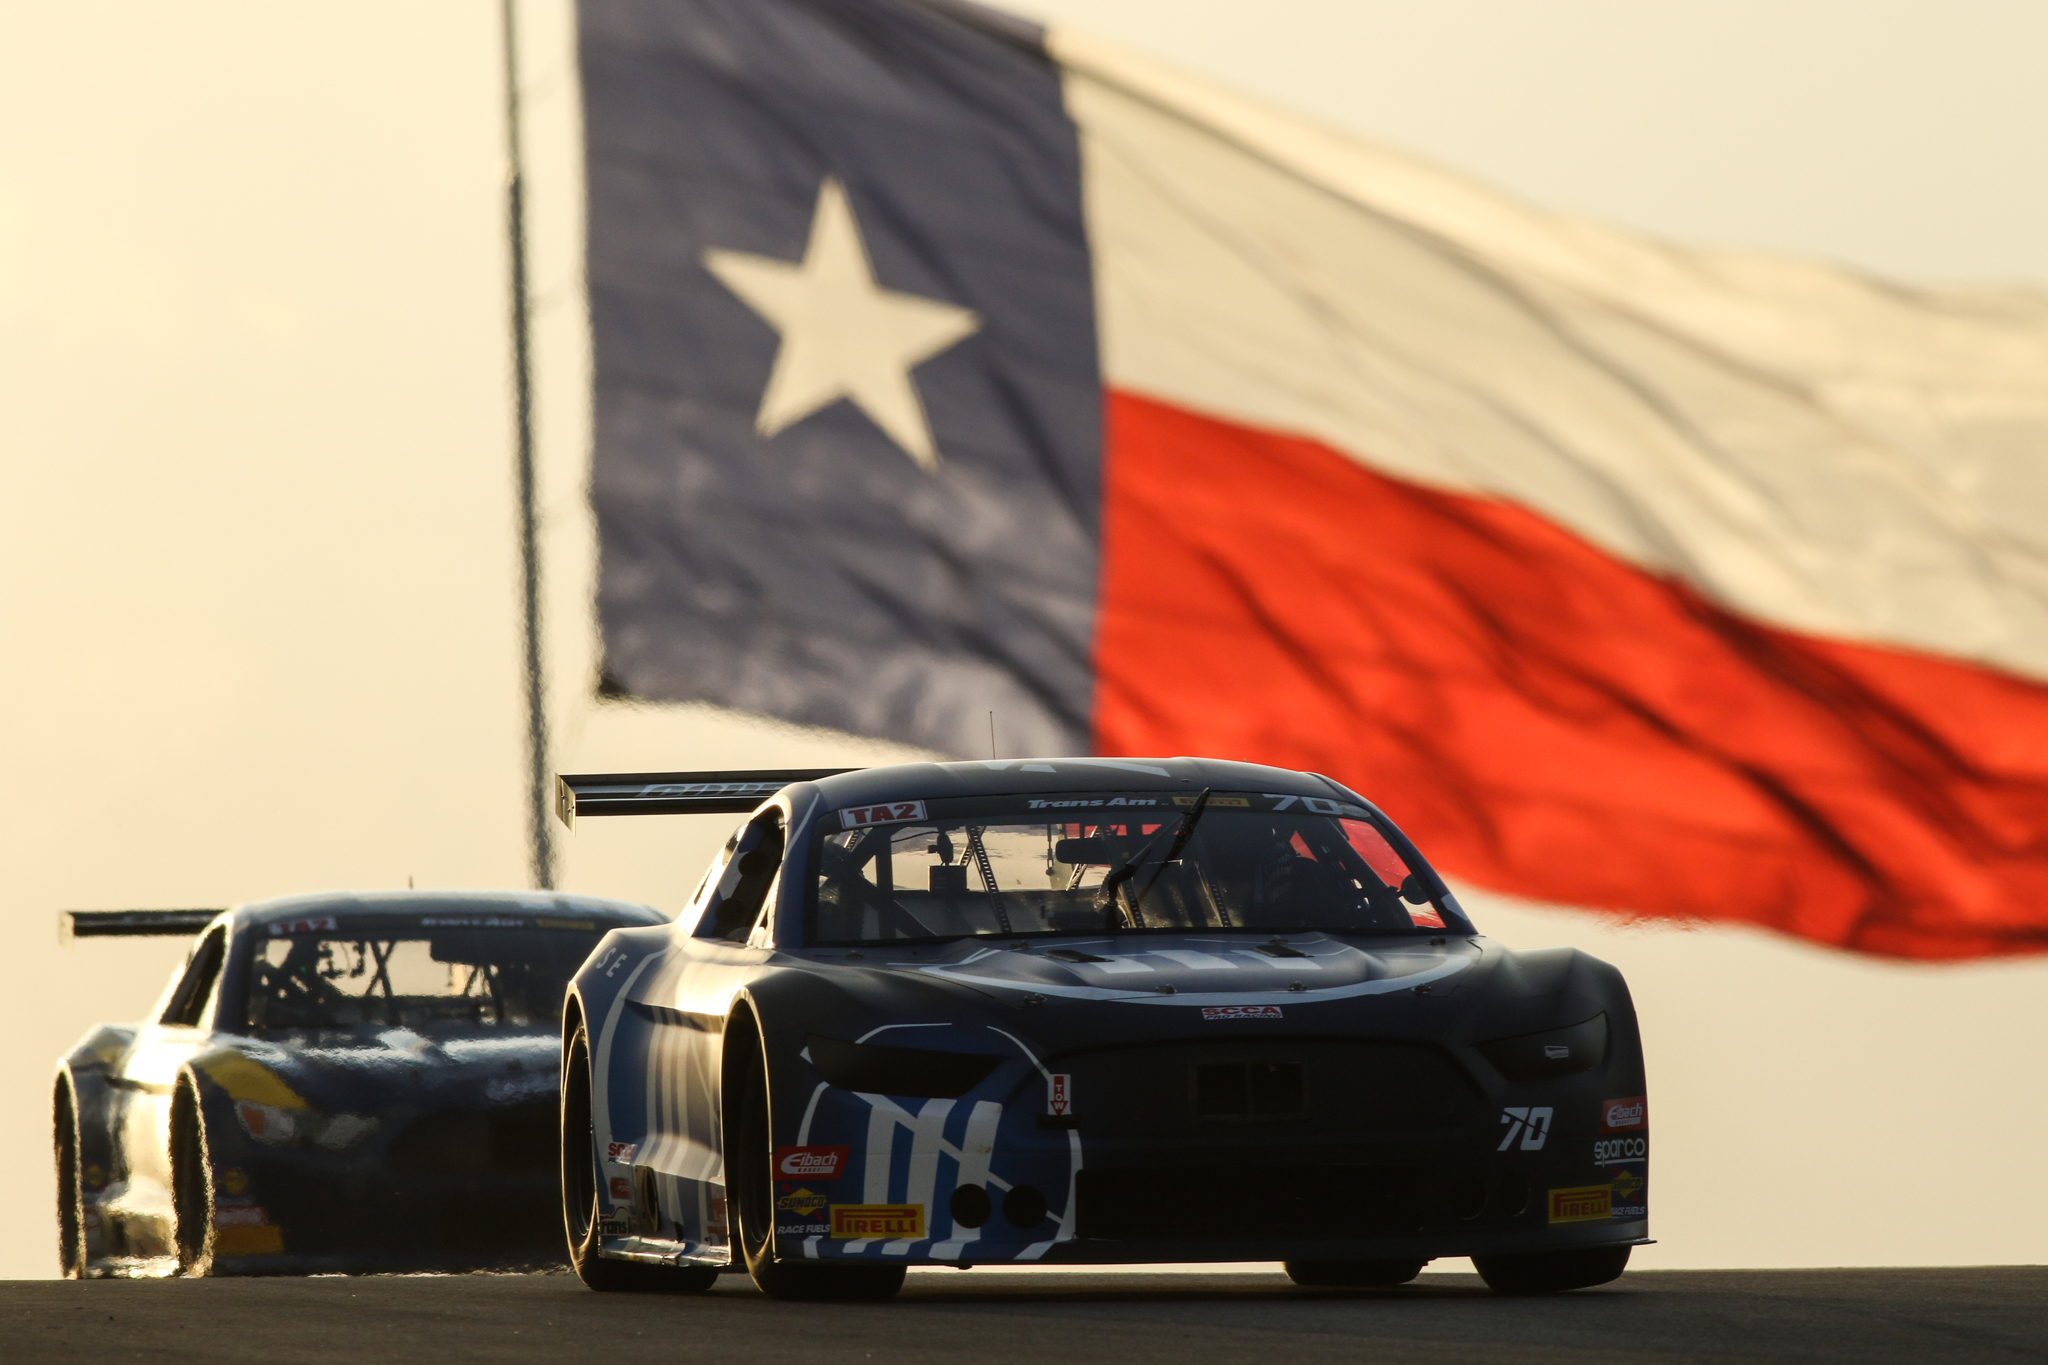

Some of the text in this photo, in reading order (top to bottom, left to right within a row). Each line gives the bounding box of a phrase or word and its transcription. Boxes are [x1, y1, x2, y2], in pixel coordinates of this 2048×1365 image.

[848, 803, 917, 824] TA2
[1028, 797, 1157, 809] Trans Am
[1262, 794, 1343, 815] 70
[1203, 1006, 1280, 1015] SCCA
[1054, 1084, 1064, 1110] TOW
[1607, 1103, 1643, 1127] Eibach
[1497, 1107, 1554, 1151] 70
[780, 1152, 838, 1174] Eibach
[1594, 1138, 1646, 1167] sparco
[780, 1196, 826, 1209] SUNOCO
[1553, 1189, 1608, 1218] PIRELLI
[1625, 1205, 1646, 1214] FUELS
[777, 1223, 831, 1235] RACE FUELS
[835, 1208, 917, 1233] PIRELLI
